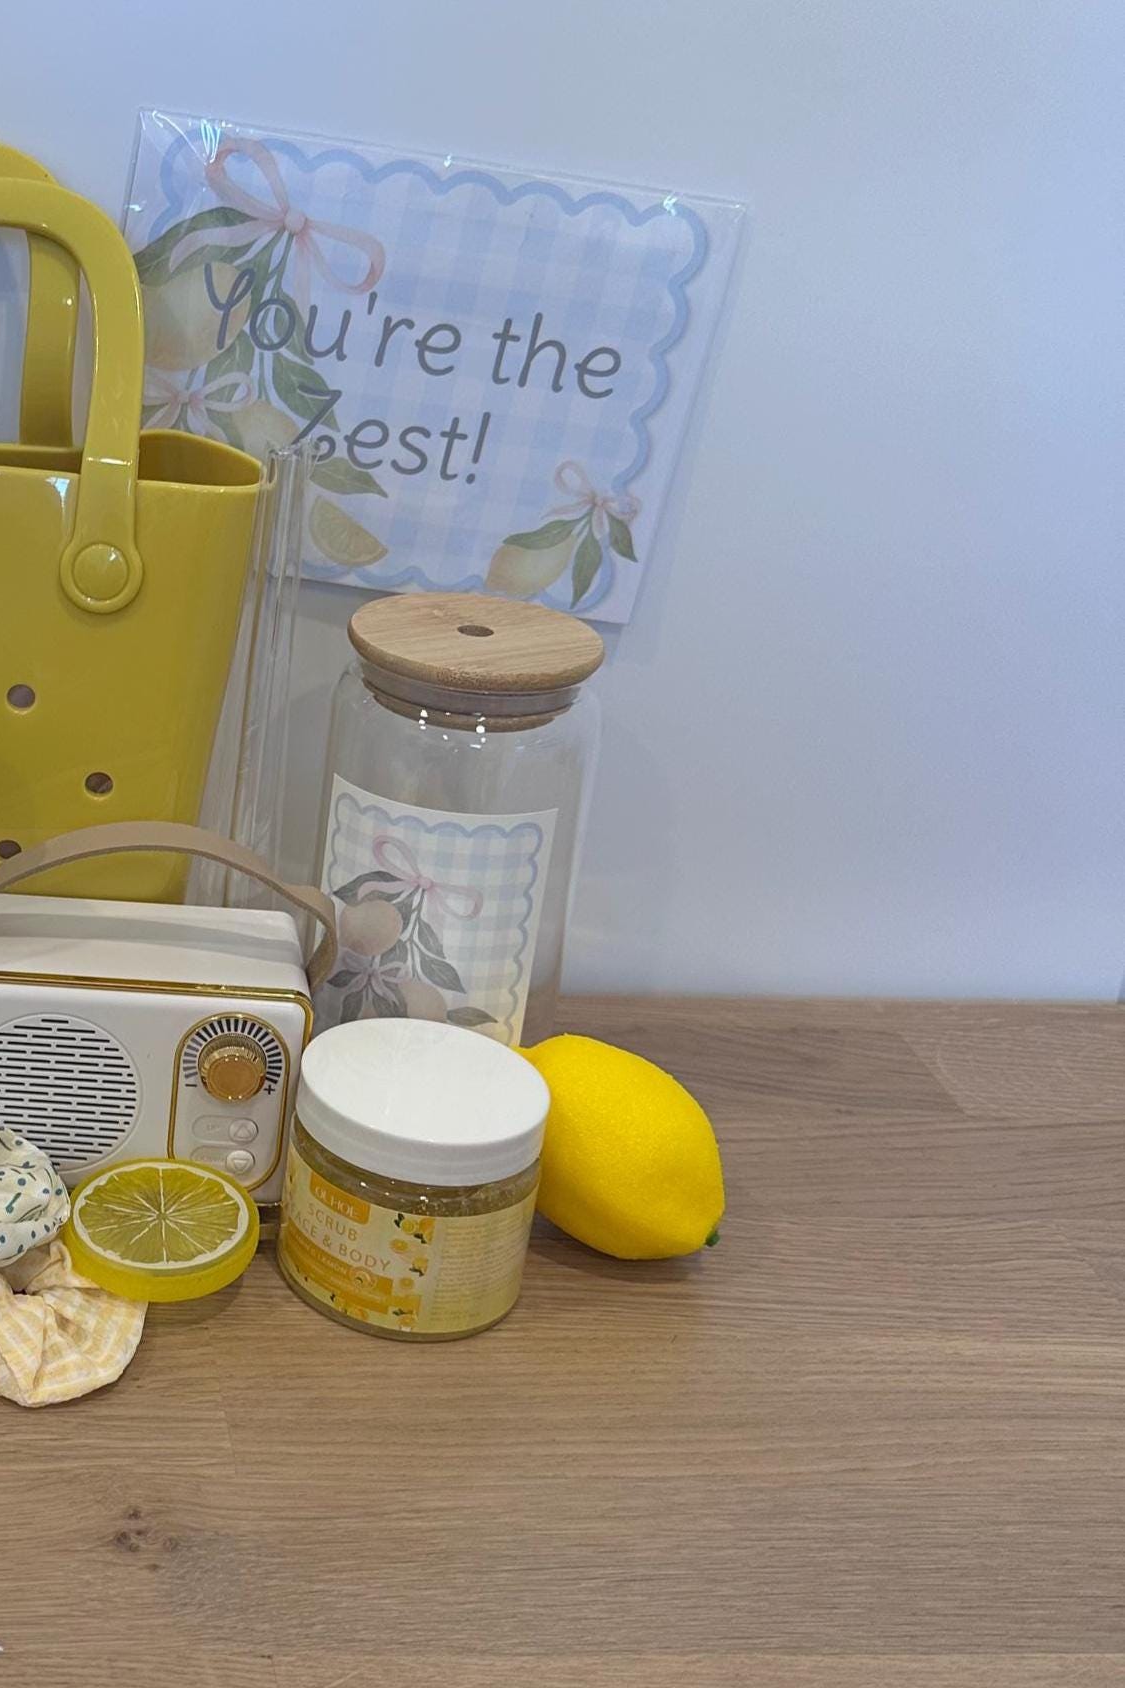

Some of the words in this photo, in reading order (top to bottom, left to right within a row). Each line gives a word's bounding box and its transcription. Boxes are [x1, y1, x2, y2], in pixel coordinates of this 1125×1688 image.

[204, 262, 462, 377] You're
[491, 312, 622, 399] the
[306, 1202, 359, 1242] SCRUB
[322, 1233, 333, 1249] &
[338, 1242, 393, 1272] BODY
